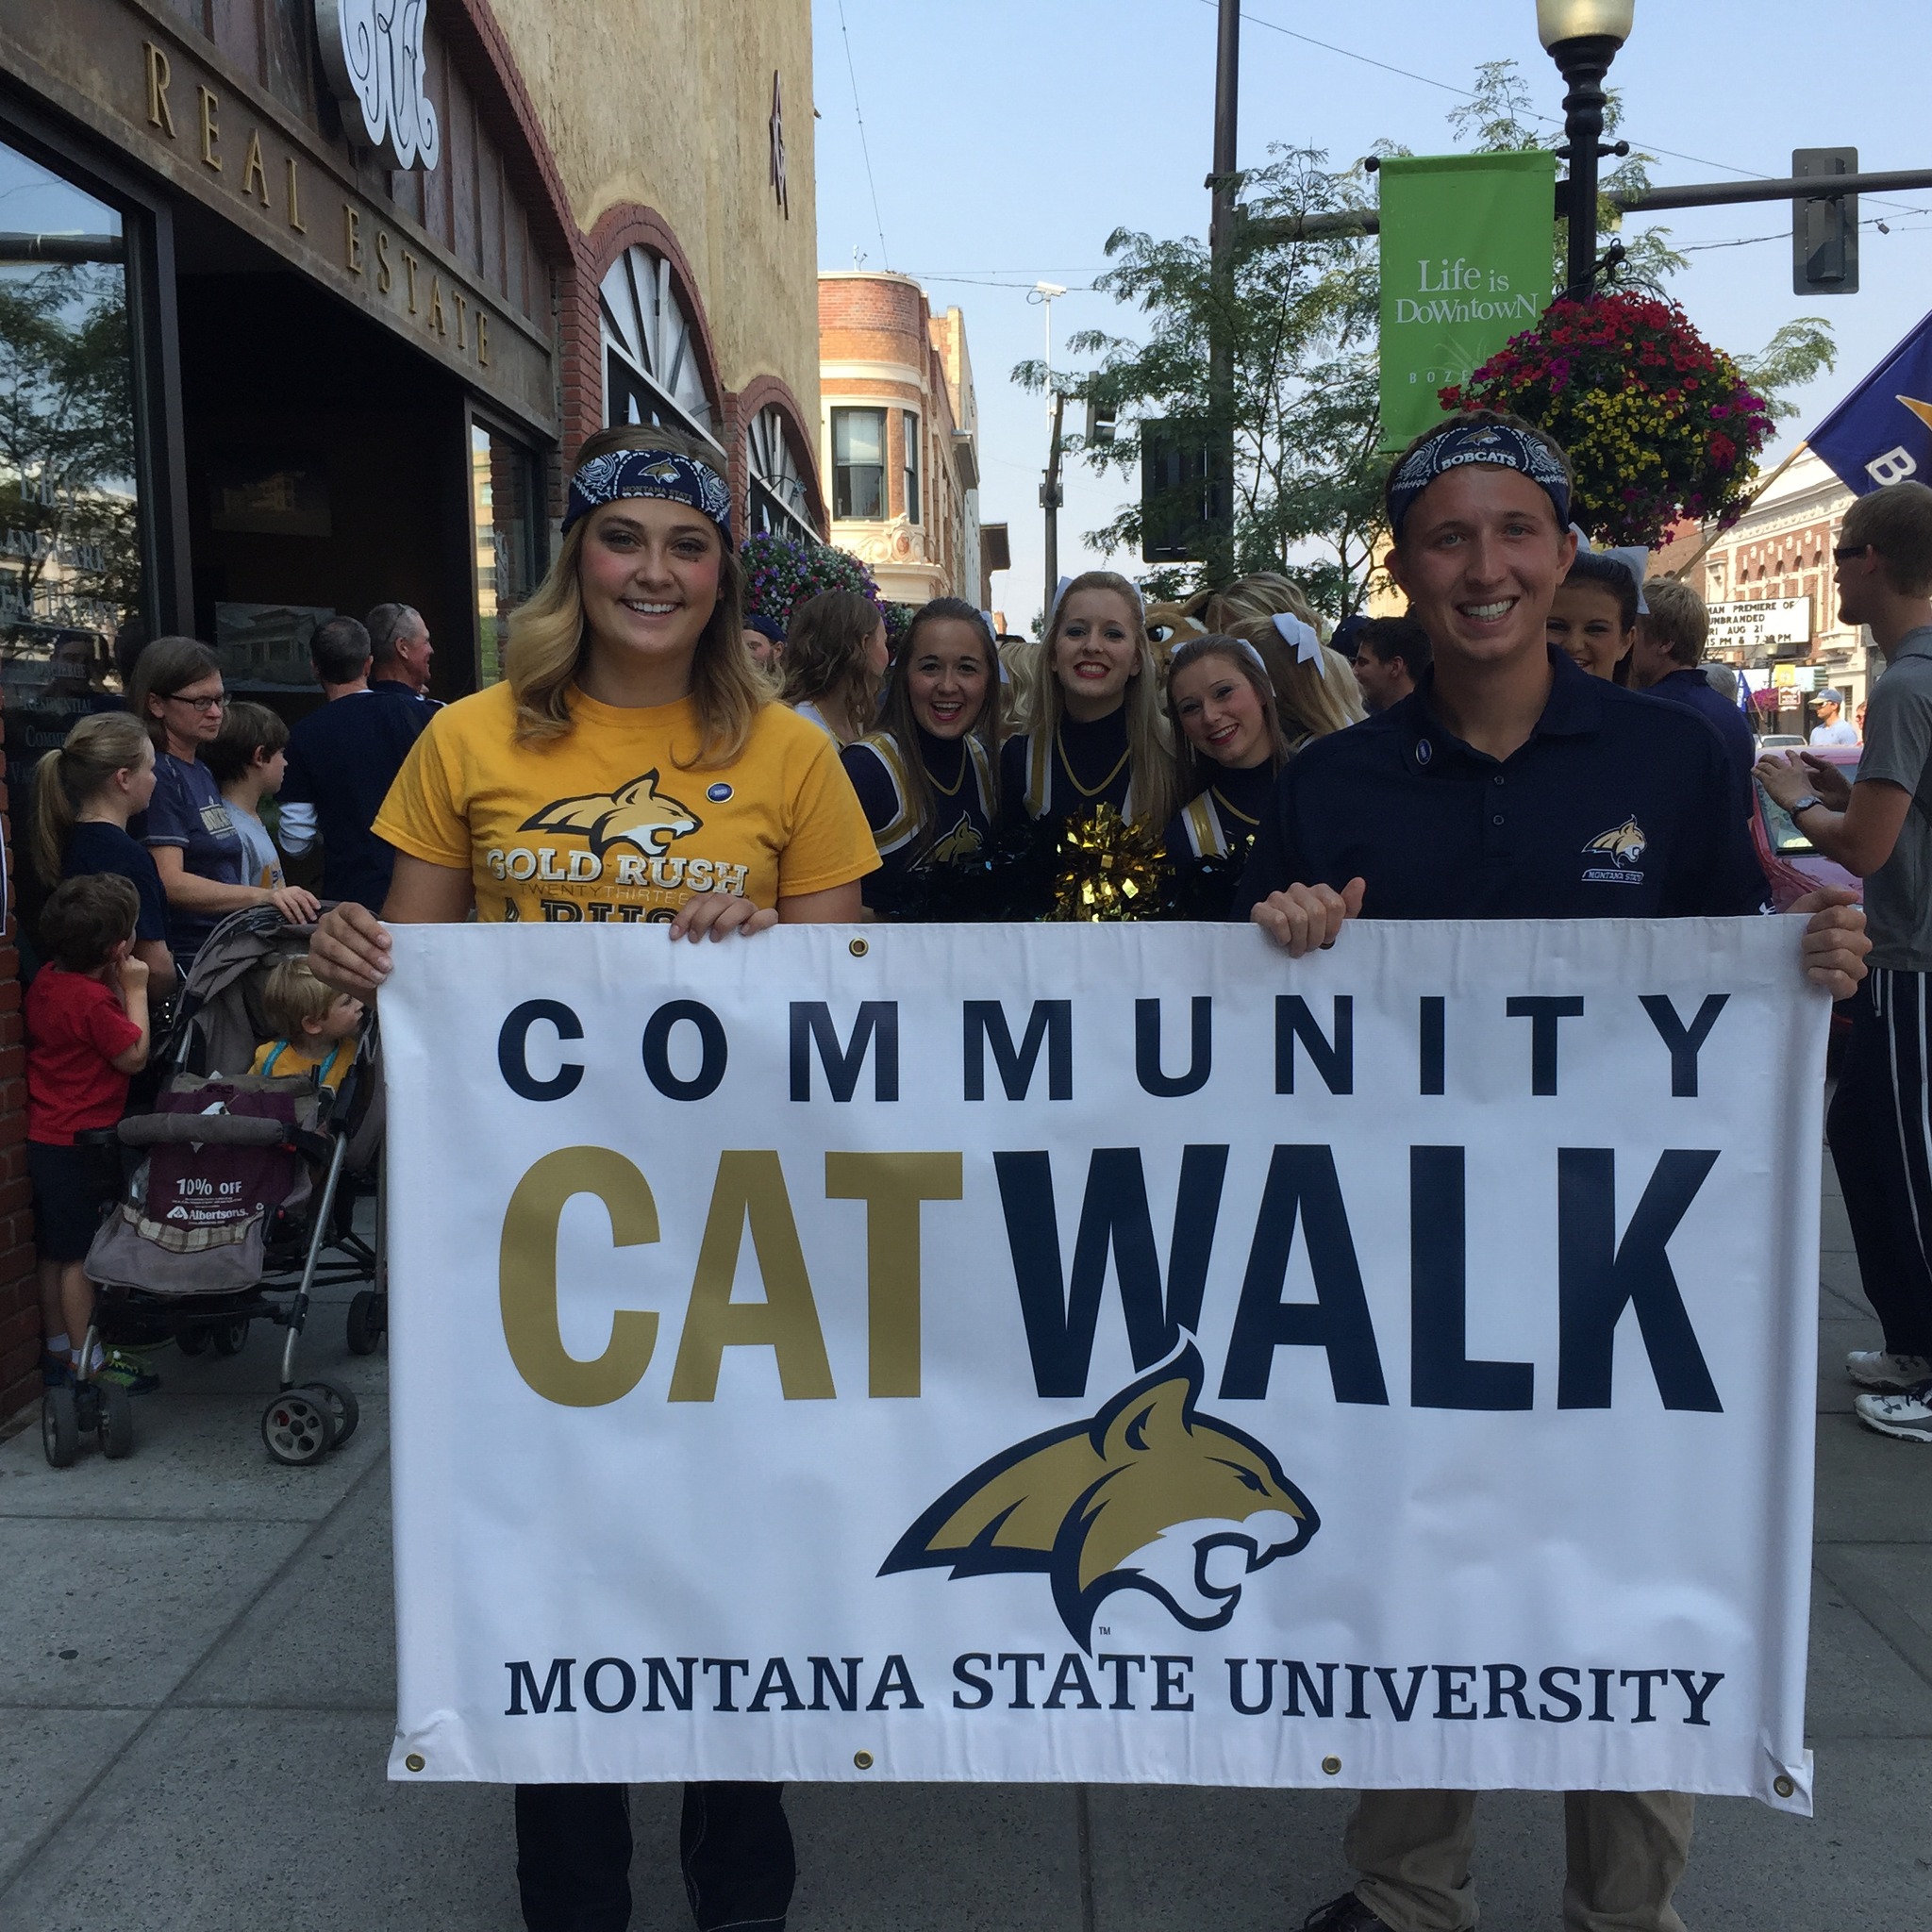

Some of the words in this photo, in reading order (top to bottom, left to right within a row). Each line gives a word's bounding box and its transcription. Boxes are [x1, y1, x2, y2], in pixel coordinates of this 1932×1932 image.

[143, 40, 308, 234] REAL
[343, 203, 490, 368] ESTATE
[1417, 257, 1481, 292] Life
[1489, 269, 1510, 292] is
[1408, 369, 1469, 384] BOZE
[1441, 452, 1518, 471] BOBCATS
[622, 485, 667, 494] MONTANA
[668, 488, 694, 502] STATE
[1733, 602, 1777, 612] PREMIERE
[1782, 601, 1795, 609] OF
[1708, 627, 1719, 636] RI
[1727, 625, 1746, 635] AUG
[1754, 625, 1763, 633] 21
[1719, 637, 1732, 645] PM
[1777, 633, 1791, 642] PM
[486, 847, 604, 883] GOLD
[615, 854, 751, 897] RUSH
[1588, 871, 1624, 880] MONTANA
[519, 883, 690, 906] TWENTYTHIRTEE
[498, 993, 1730, 1102] COMMUNITY
[176, 1178, 212, 1195] 10%
[219, 1181, 242, 1194] OFF
[499, 1144, 1723, 1412] CATWALK
[505, 1655, 924, 1716] MONTANA
[952, 1653, 1194, 1712] STATE
[1224, 1657, 1725, 1726] UNIVERSITY
